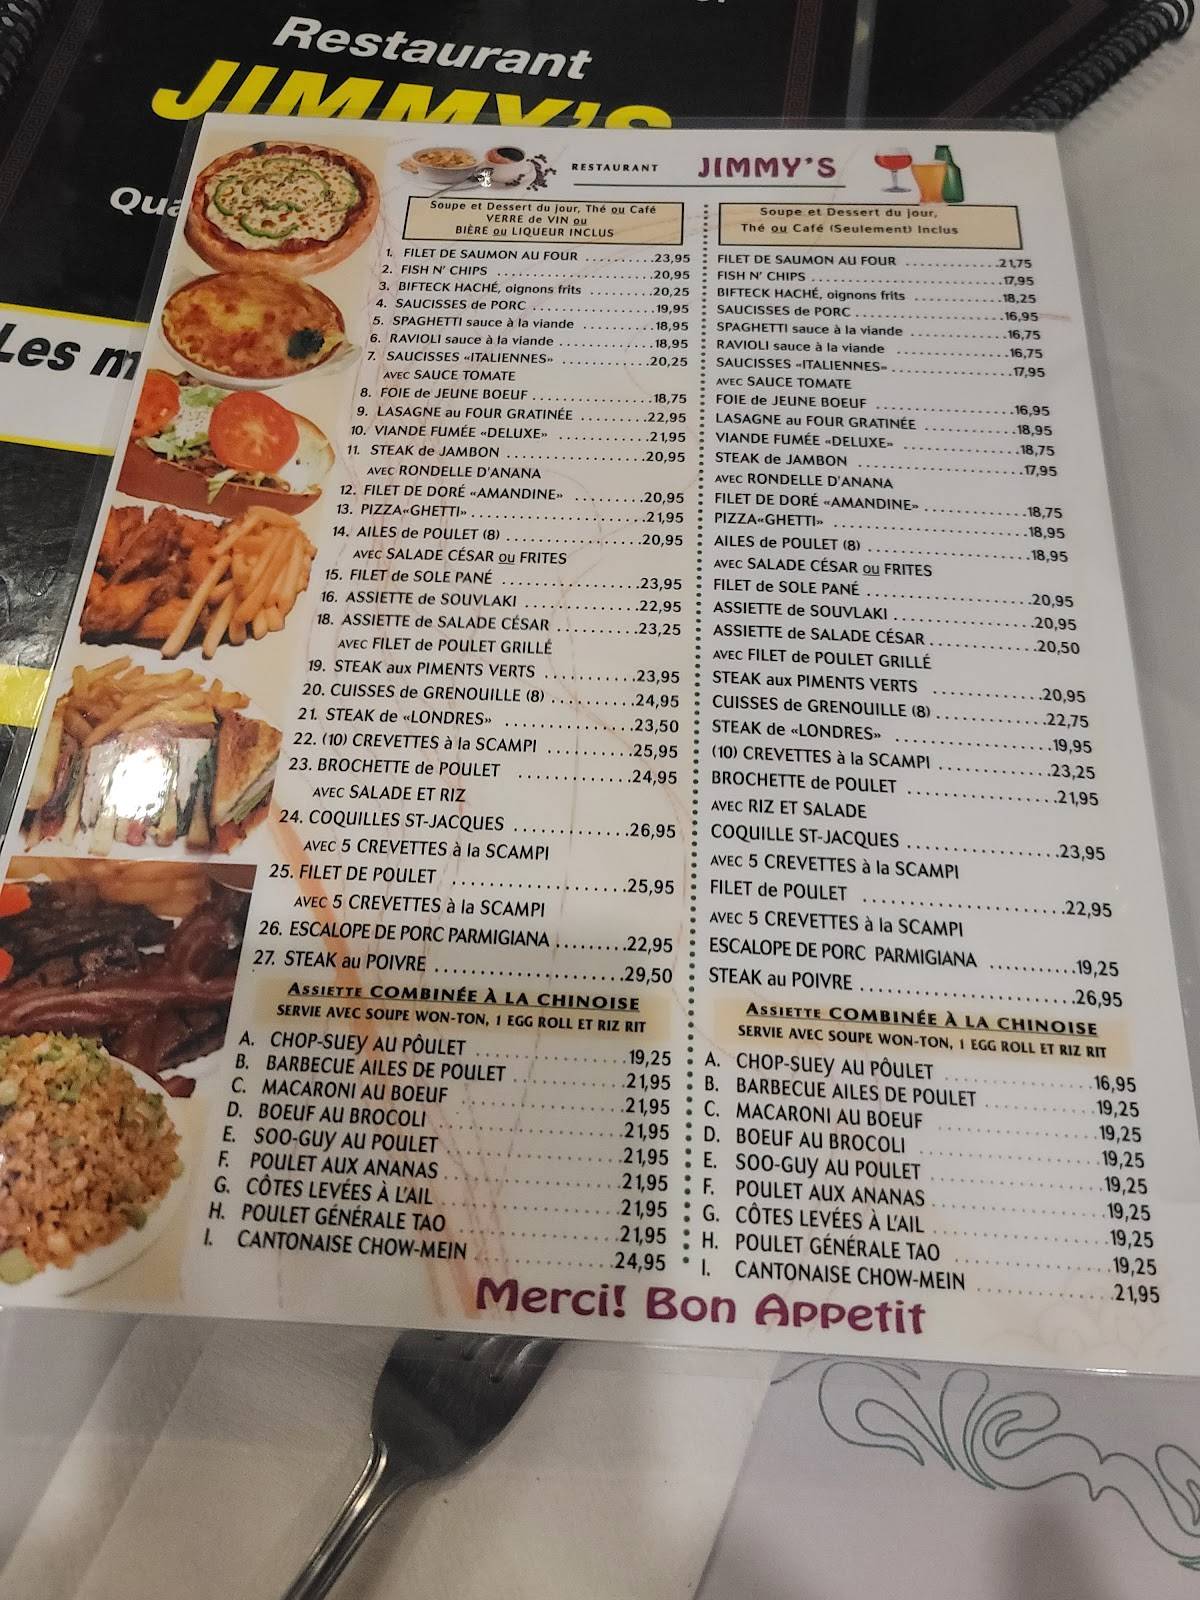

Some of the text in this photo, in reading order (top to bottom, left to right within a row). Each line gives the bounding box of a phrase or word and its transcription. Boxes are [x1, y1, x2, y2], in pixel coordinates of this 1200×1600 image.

[272, 15, 592, 80] Restaurant
[571, 157, 836, 178] RESTAURANT JIMMY'S
[430, 200, 466, 211] Soupe
[470, 202, 482, 211] et
[487, 202, 532, 213] Dessert
[536, 204, 551, 213] du
[586, 204, 607, 214] Thé
[611, 206, 625, 216] ou
[630, 205, 657, 215] Café
[486, 214, 587, 226] VERRE de VIN ou
[760, 207, 802, 217] Soupe
[807, 208, 821, 216] et
[826, 207, 879, 216] Dessert
[885, 208, 901, 217] du
[455, 224, 614, 237] BIÈRE ou LIQUEUR INCLUS
[740, 223, 958, 234] Thé ou Café (Seulement) Inclus
[403, 248, 436, 258] FILET
[439, 249, 456, 258] DE
[460, 249, 517, 259] SAUMON
[521, 251, 539, 260] AU
[543, 251, 577, 260] FOUR
[654, 253, 690, 264] 23,95
[717, 270, 745, 280] FISH
[766, 271, 805, 281] CHIPS
[1003, 276, 1034, 286] 17,95
[0, 323, 81, 371] Les
[716, 357, 791, 369] SAUCISSES
[1013, 366, 1045, 378] 17,95
[356, 406, 686, 424] 9. LASAGNE au FOUR GRATINÉE 22,95
[715, 432, 769, 444] VIANDE
[774, 432, 820, 446] FUMÉE
[1020, 444, 1055, 456] 18,75
[1028, 526, 1065, 539] 18,95
[352, 546, 567, 565] AVEC SALADE CÉSAR ou FRITES
[714, 578, 1073, 608] FILET de SOLE PANÉ 20,95
[317, 613, 680, 637] 18. ASSIETTE de SALADE CÉSAR 23,25
[288, 757, 677, 786] 23. BROCHETTE de POULET 24,95
[712, 745, 1095, 780] (10) CREVETTES à la SCAMPI 23,25
[711, 823, 1105, 861] COQUILLE ST-JACQUES 23,95
[258, 920, 672, 954] 26. ESCALOPE DE PORC PARMIGIANA 22,95
[370, 985, 477, 1002] COMBINÉE
[484, 987, 497, 1003] À
[505, 991, 528, 1004] LA
[537, 993, 639, 1008] CHINOISE
[709, 966, 1122, 1008] STEAK au POIVRE 26,95
[276, 1004, 321, 1017] SERVIE
[326, 1006, 360, 1019] AVEC
[365, 1007, 409, 1021] SOUPE
[415, 1010, 489, 1026] WON-TON,
[507, 1015, 533, 1027] EGG
[537, 1016, 573, 1029] ROLL
[577, 1018, 593, 1030] ET
[597, 1019, 619, 1031] RIZ
[625, 1021, 646, 1032] RIT
[705, 1075, 1139, 1117] B. BARBECUE AILES DE POULET 19,25
[226, 1101, 669, 1141] D. BOEUF AU BROCOLI 21,95
[214, 1176, 229, 1193] G.
[246, 1173, 303, 1197] CÔTES
[308, 1178, 372, 1201] LEVÉES
[376, 1180, 389, 1202] À
[621, 1199, 667, 1219] 21,95
[703, 1177, 1150, 1222] F. POULET AUX ANANAS 19,25
[237, 1229, 353, 1253] CANTONAISE
[358, 1236, 466, 1260] CHOW-MEIN
[615, 1252, 665, 1272] 24,95
[702, 1231, 1156, 1277] H. POULET GÉNÉRALE TAO 19,25
[476, 1277, 926, 1334] Merci! Bon Appetit
